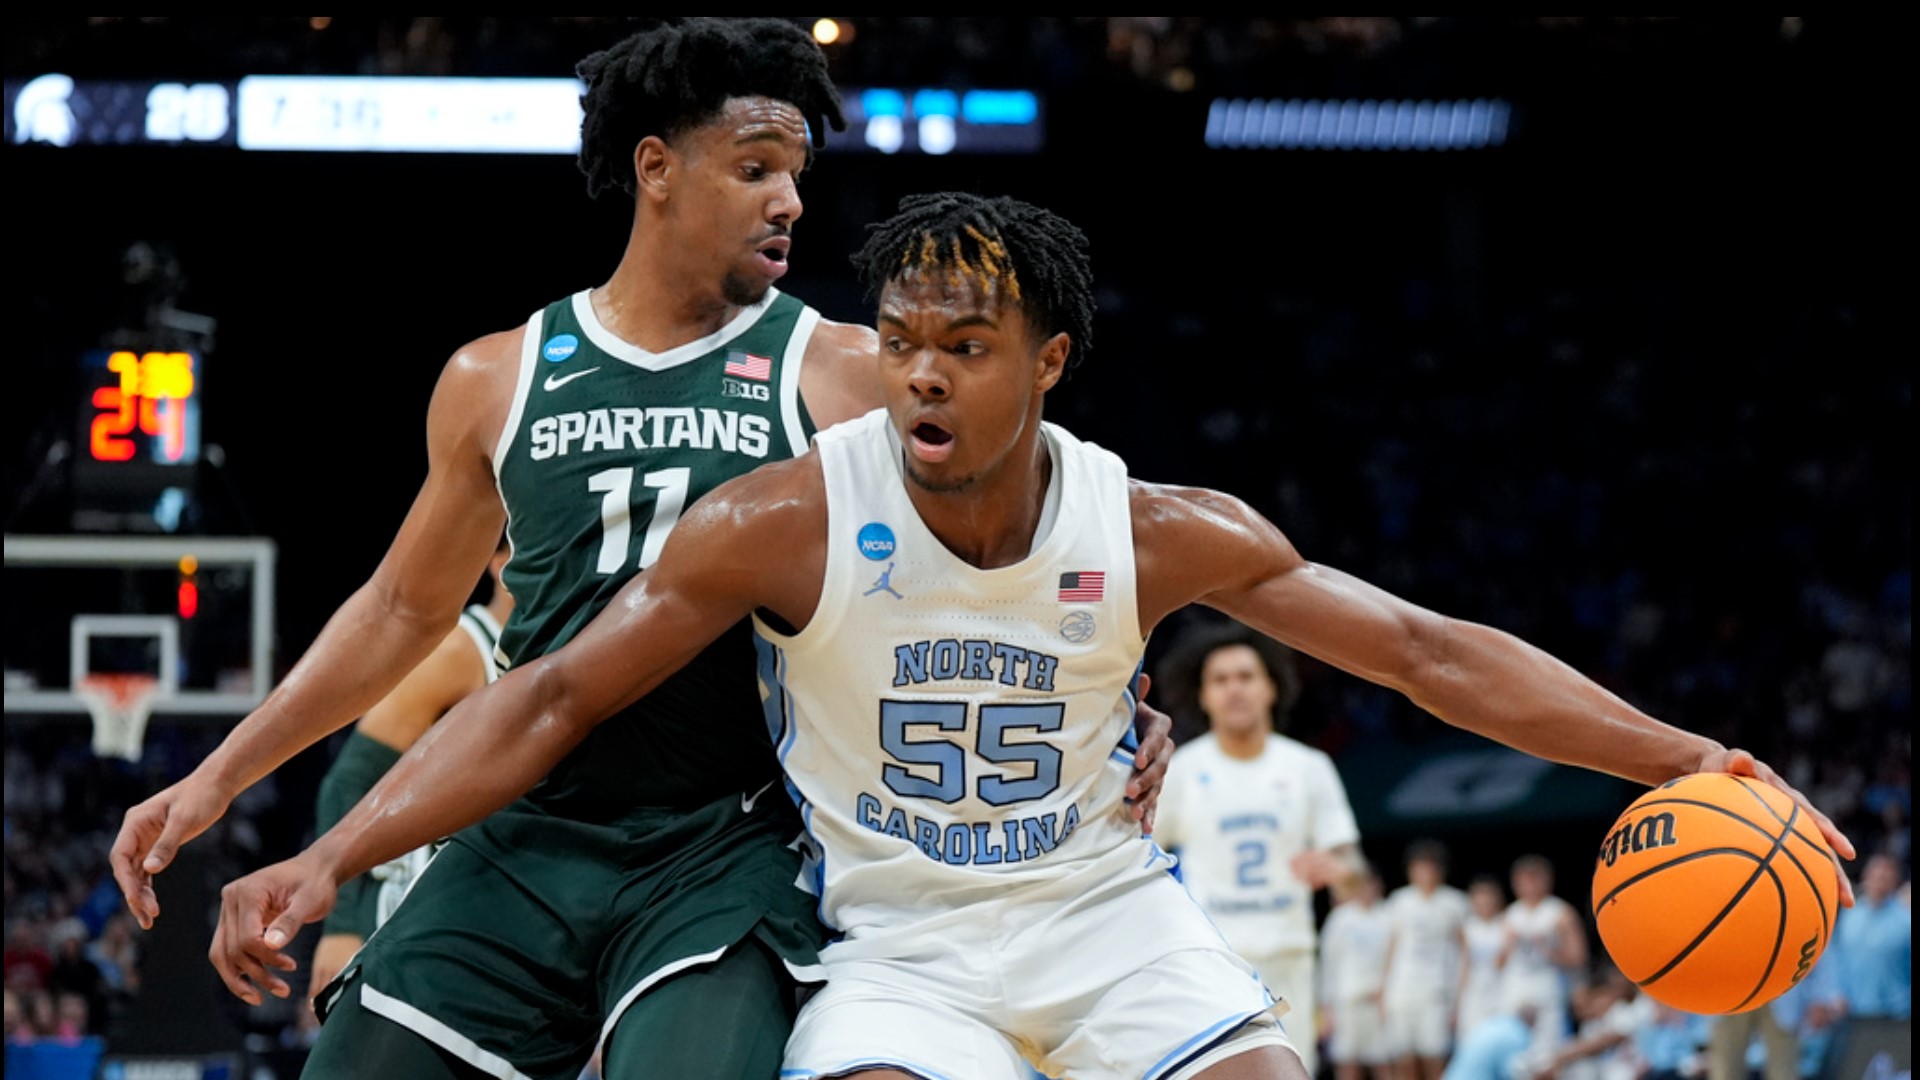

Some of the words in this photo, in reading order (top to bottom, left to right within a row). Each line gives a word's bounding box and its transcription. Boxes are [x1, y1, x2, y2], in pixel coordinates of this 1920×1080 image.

[530, 406, 771, 461] SPARTANS
[588, 467, 691, 574] 11
[862, 540, 893, 551] NCAA
[892, 639, 1058, 691] NORTH
[879, 698, 1066, 807] 55
[856, 791, 1081, 866] CAROLINA
[1236, 841, 1268, 887] 2
